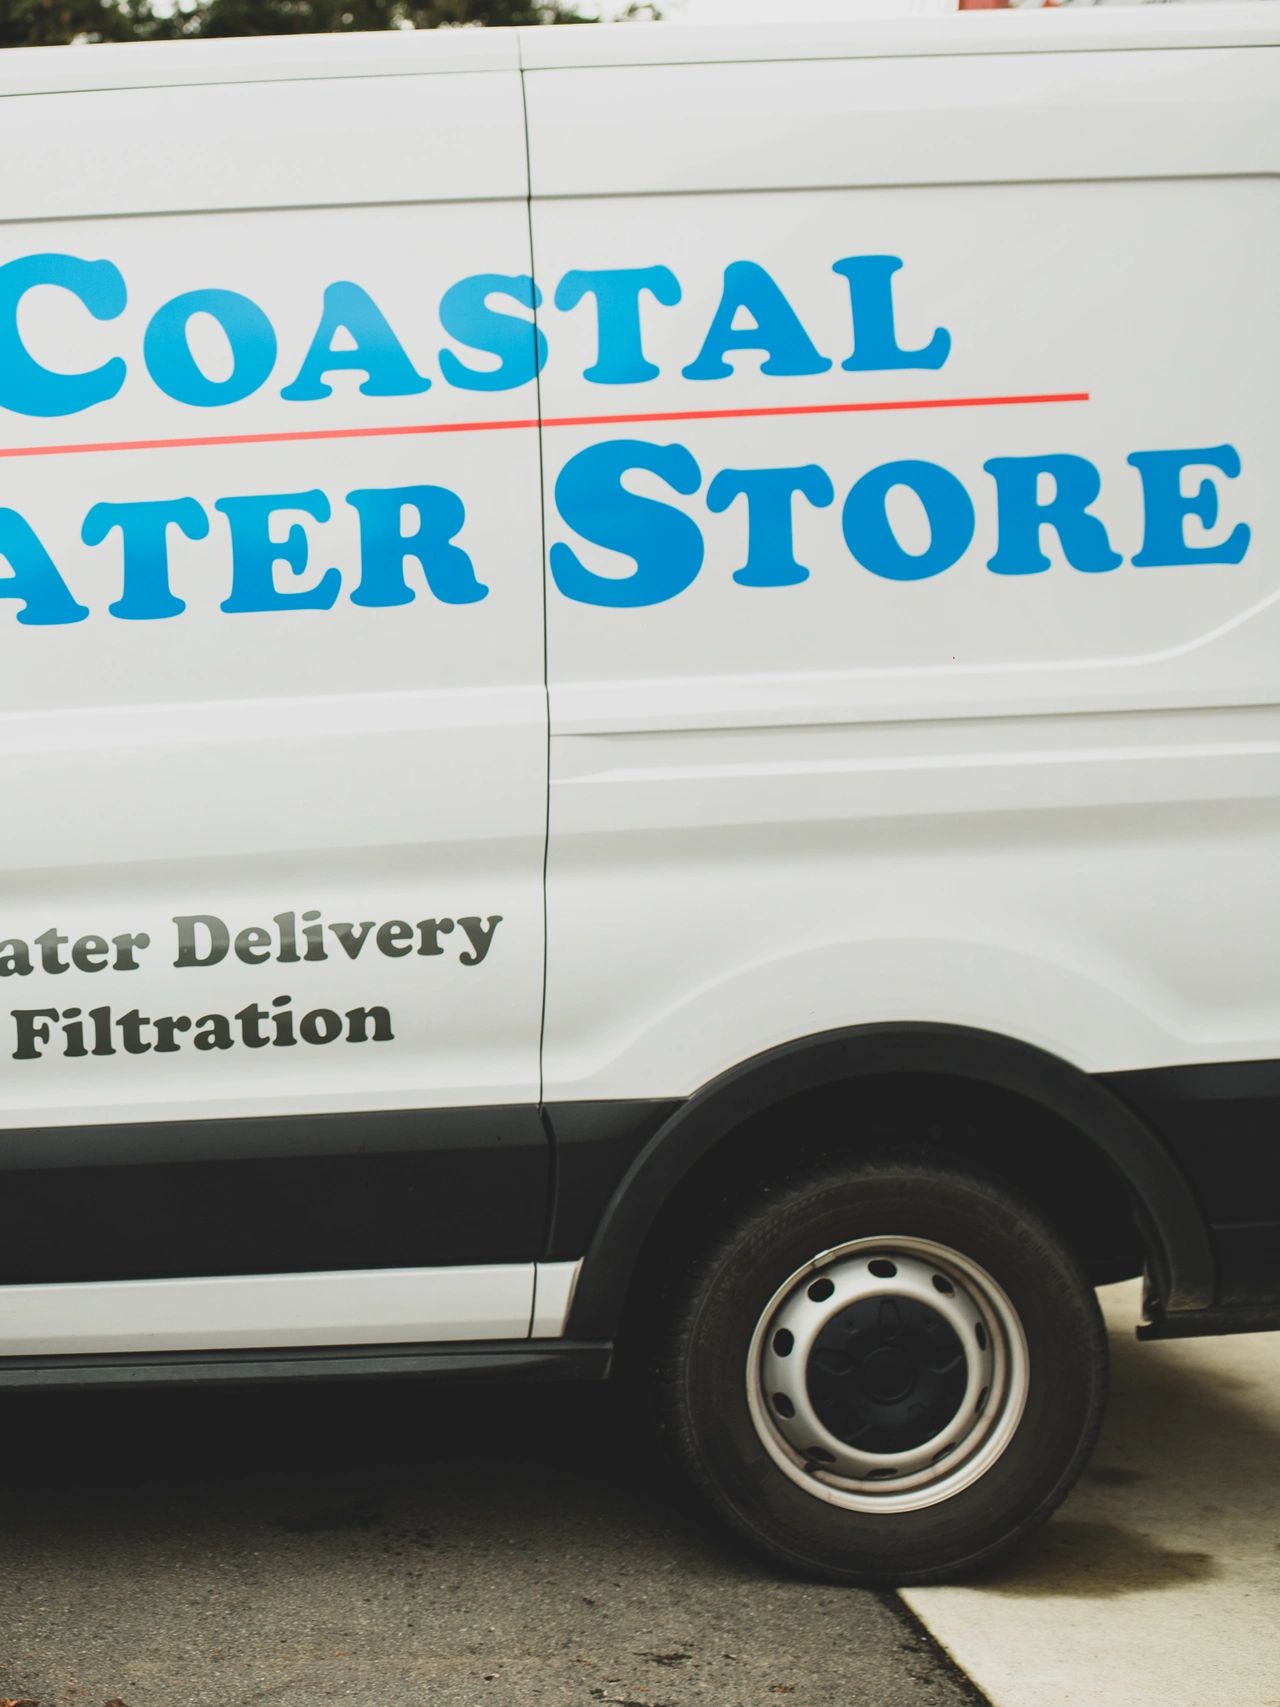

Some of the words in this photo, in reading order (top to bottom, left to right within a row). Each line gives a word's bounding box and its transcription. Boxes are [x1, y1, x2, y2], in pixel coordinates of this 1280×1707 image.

[549, 438, 1251, 608] STORE
[172, 910, 504, 966] Delivery
[10, 994, 396, 1060] Filtration
